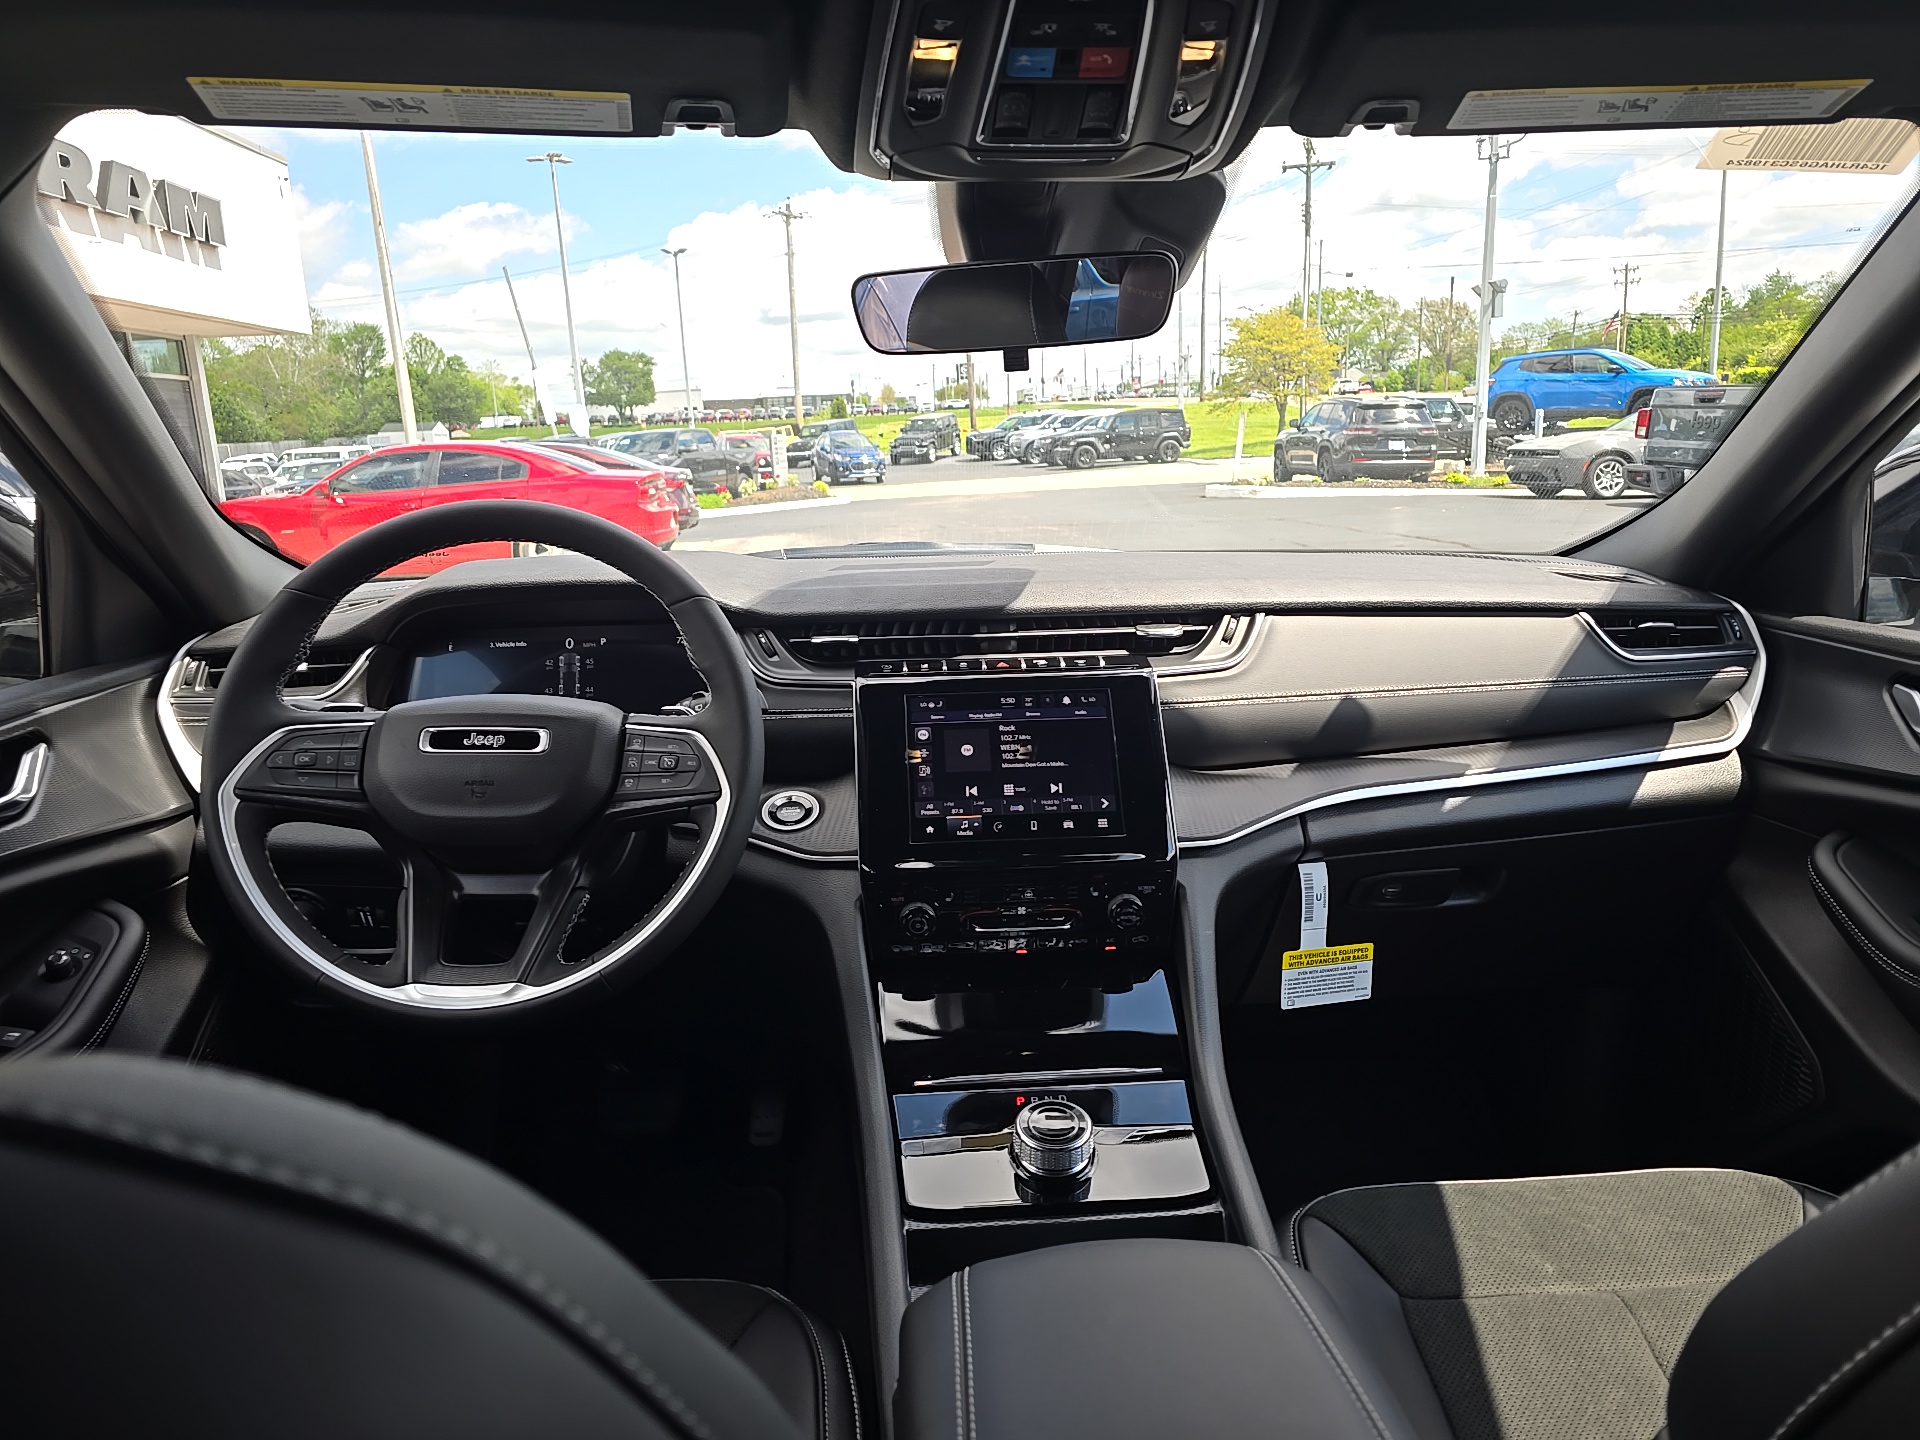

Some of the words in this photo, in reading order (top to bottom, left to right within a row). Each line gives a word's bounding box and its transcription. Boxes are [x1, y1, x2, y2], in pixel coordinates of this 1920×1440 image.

[37, 138, 227, 248] RAM
[1687, 410, 1722, 433] Jeep
[565, 637, 575, 650] 0
[600, 637, 607, 646] P
[998, 724, 1017, 732] Rock
[463, 732, 506, 748] Jeep
[1000, 734, 1018, 742] 102.7
[299, 755, 311, 763] OK
[1315, 893, 1322, 901] U
[1288, 953, 1304, 961] THIS
[1304, 951, 1330, 960] VEHICLE
[1338, 947, 1370, 956] EQUIPPED
[1305, 957, 1340, 967] ADVANCED
[1352, 953, 1369, 961] BAGS
[1017, 1097, 1026, 1106] P
